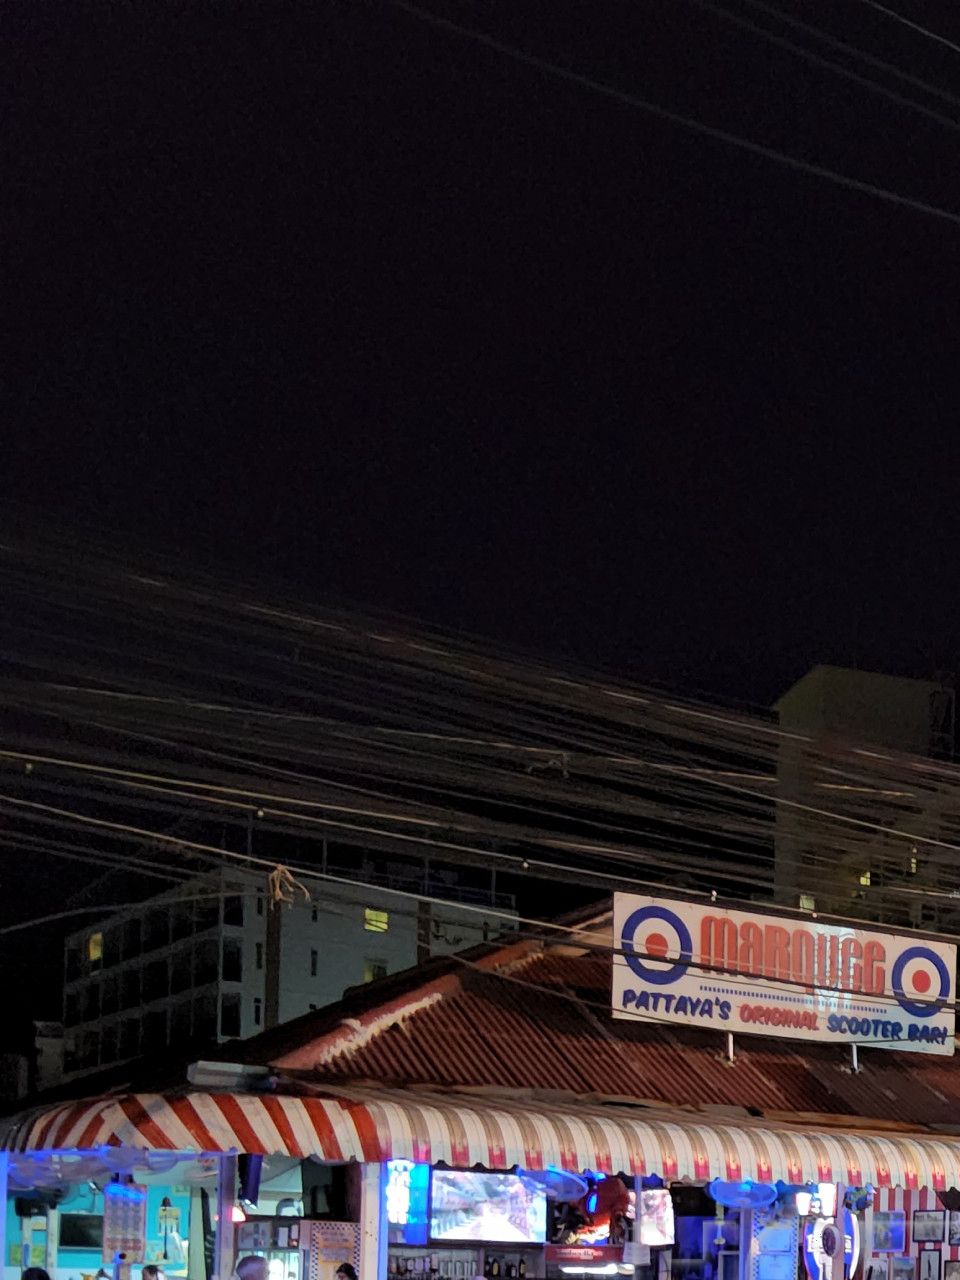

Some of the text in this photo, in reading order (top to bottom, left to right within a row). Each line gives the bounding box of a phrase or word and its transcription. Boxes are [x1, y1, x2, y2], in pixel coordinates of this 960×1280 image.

[622, 989, 732, 1020] PATTAYA'S
[739, 1003, 819, 1031] ORIGINAL
[827, 1013, 903, 1040] SCOOTER
